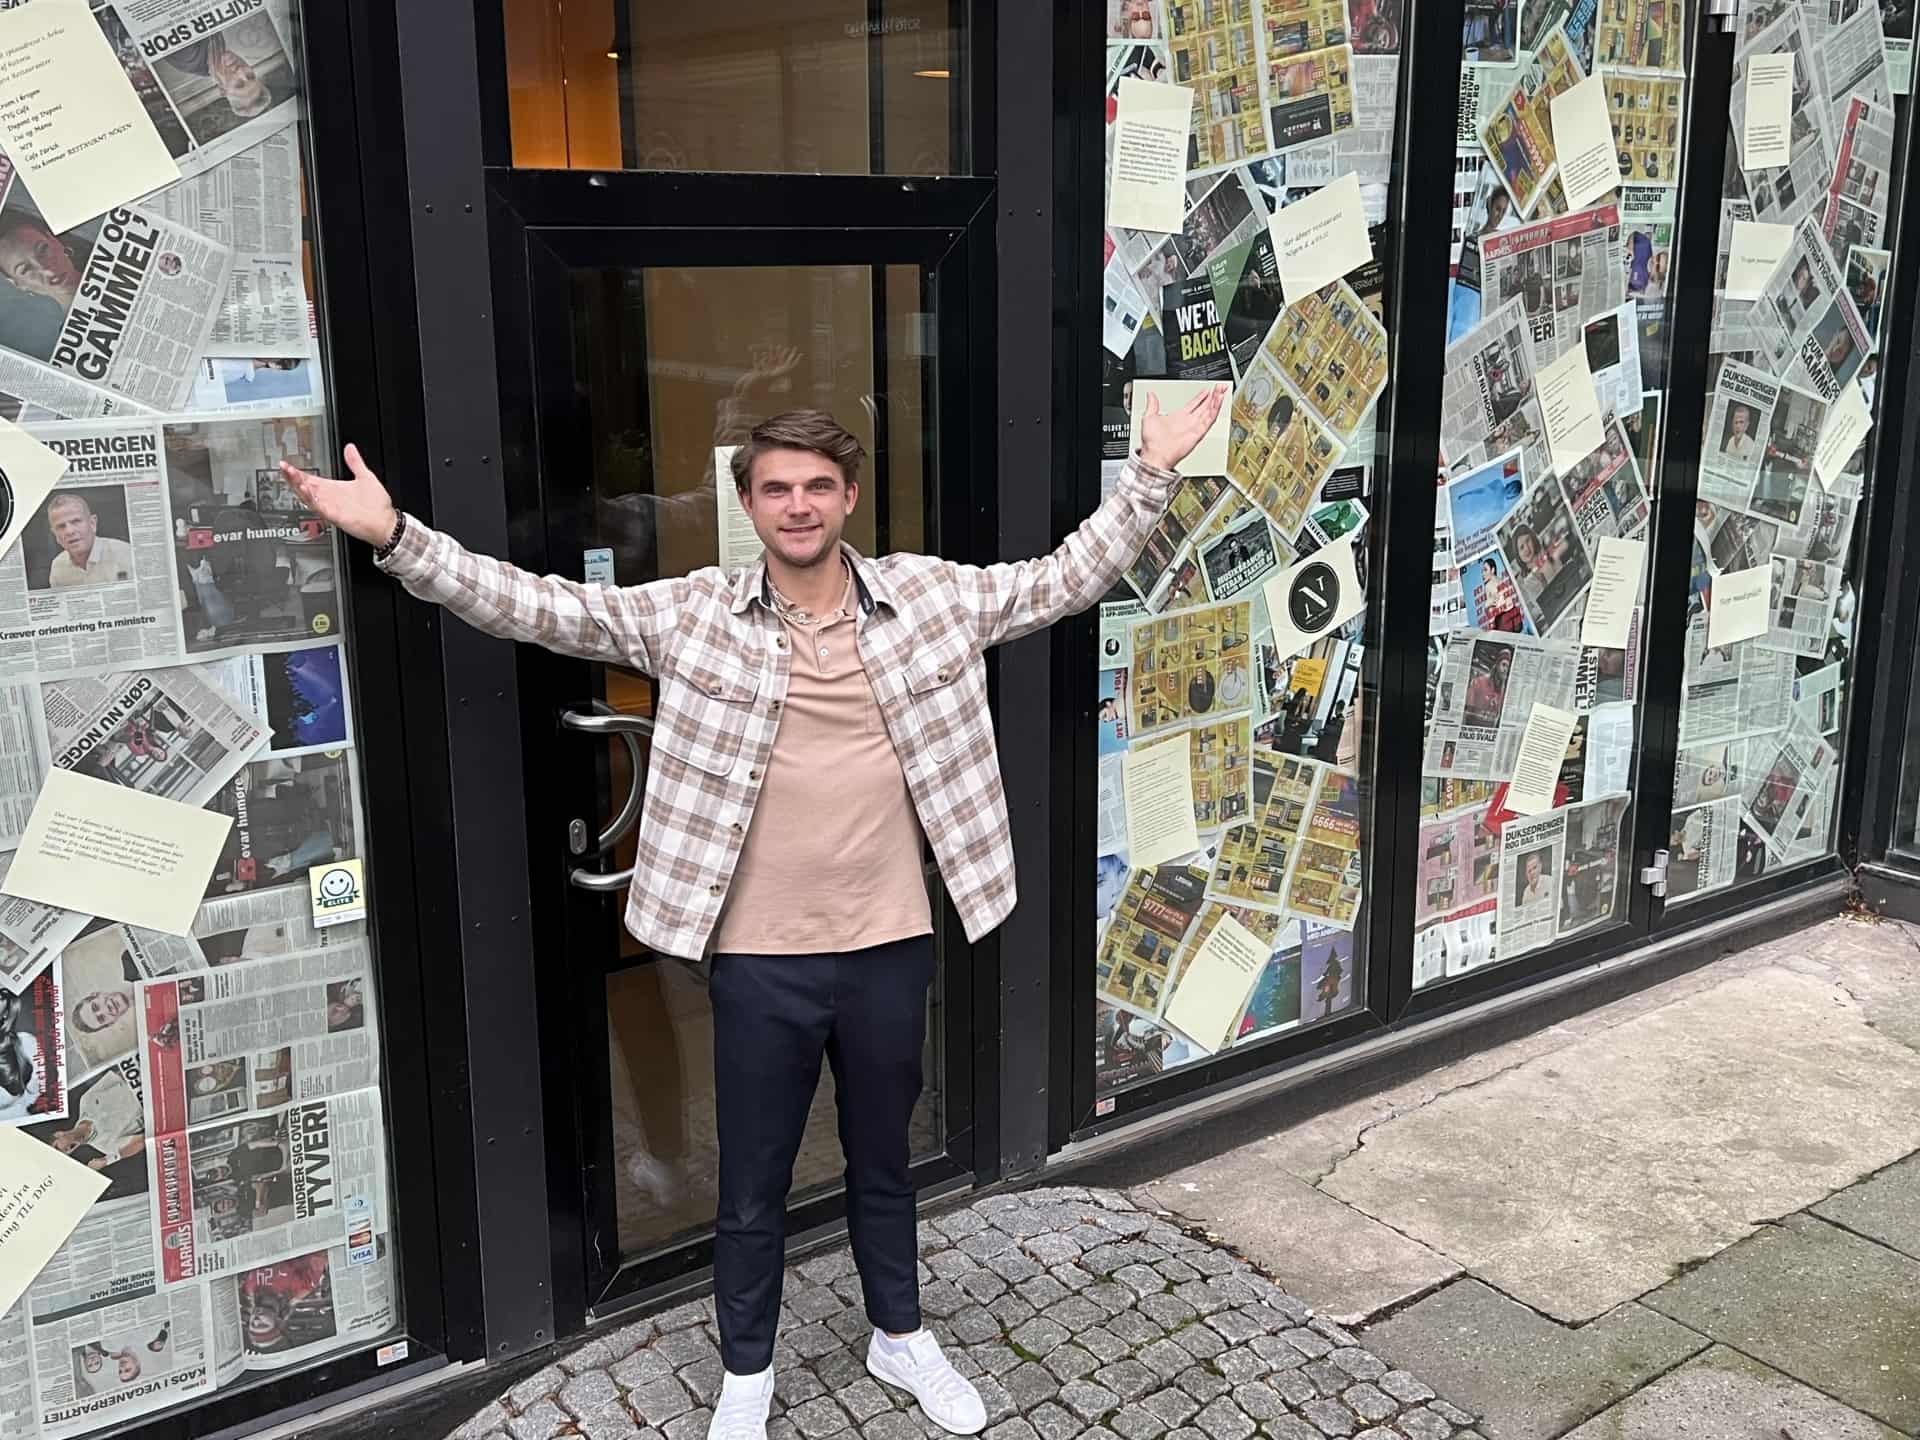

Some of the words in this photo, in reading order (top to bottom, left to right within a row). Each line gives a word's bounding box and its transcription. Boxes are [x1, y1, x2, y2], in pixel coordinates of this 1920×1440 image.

[140, 24, 191, 57] SPOR
[1473, 84, 1480, 98] RO
[80, 244, 115, 301] STIV
[102, 207, 132, 243] OG
[1176, 299, 1221, 333] WE'R
[1181, 325, 1225, 360] BACK!
[41, 434, 156, 457] DRENGEN
[67, 453, 158, 473] TREMMER
[38, 622, 96, 639] orientering
[97, 618, 114, 632] fra
[113, 613, 157, 627] ministre
[1588, 656, 1598, 687] STIV
[119, 676, 153, 712] GØR
[99, 704, 126, 732] NU
[1312, 814, 1336, 830] 6666
[1505, 815, 1565, 842] DUKSEDRENGEN
[119, 1057, 143, 1091] FOR
[290, 1106, 304, 1149] OVER
[292, 1147, 305, 1168] SIG
[300, 1100, 333, 1217] TYVERI
[295, 1166, 308, 1220] UNDRER
[178, 1222, 195, 1278] AARHUS
[351, 1248, 373, 1262] VISA
[170, 1366, 207, 1386] KAOS
[42, 1382, 162, 1425] VEGANERPARTIET
